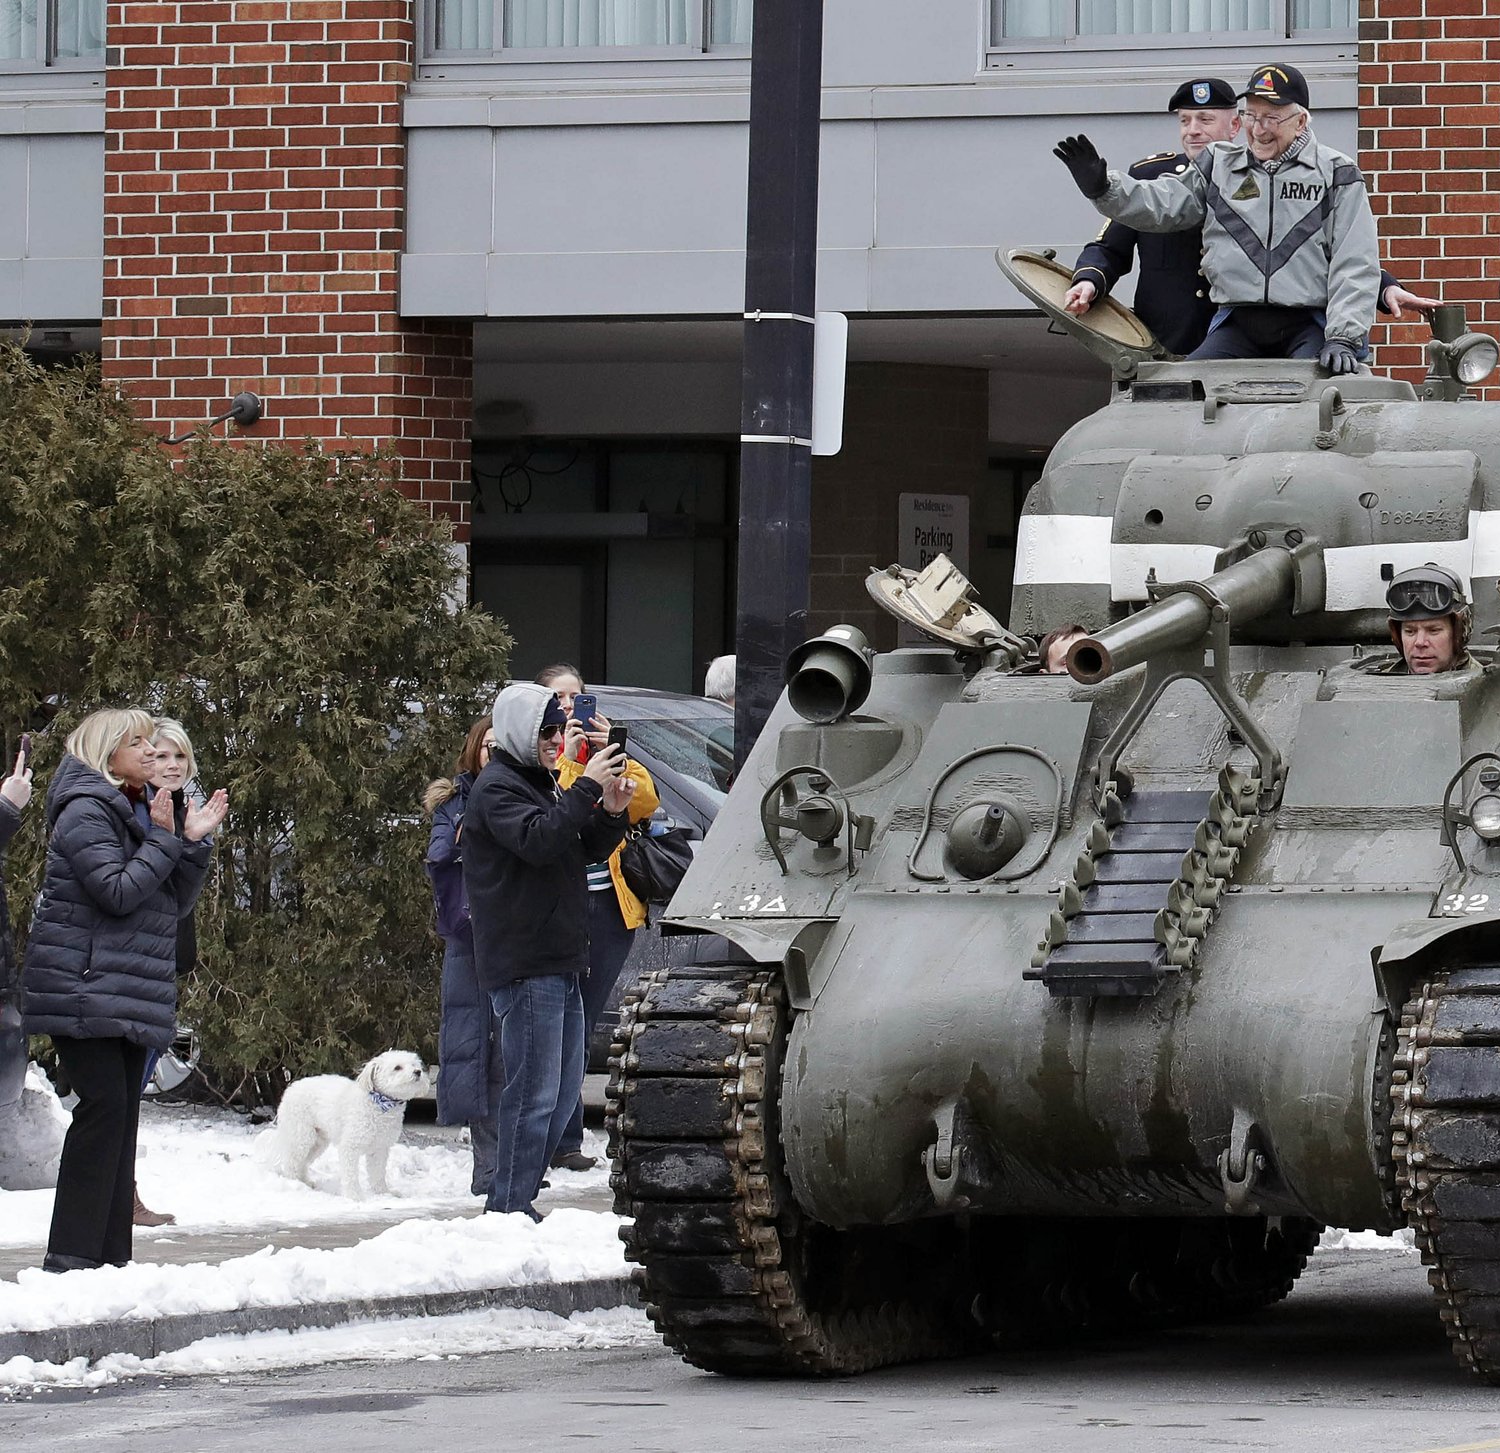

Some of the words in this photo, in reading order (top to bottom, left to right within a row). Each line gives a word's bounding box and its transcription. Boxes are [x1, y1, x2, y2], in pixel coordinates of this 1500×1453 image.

[1280, 182, 1322, 201] ARMY
[914, 526, 953, 552] Parking
[1443, 893, 1489, 912] 32
